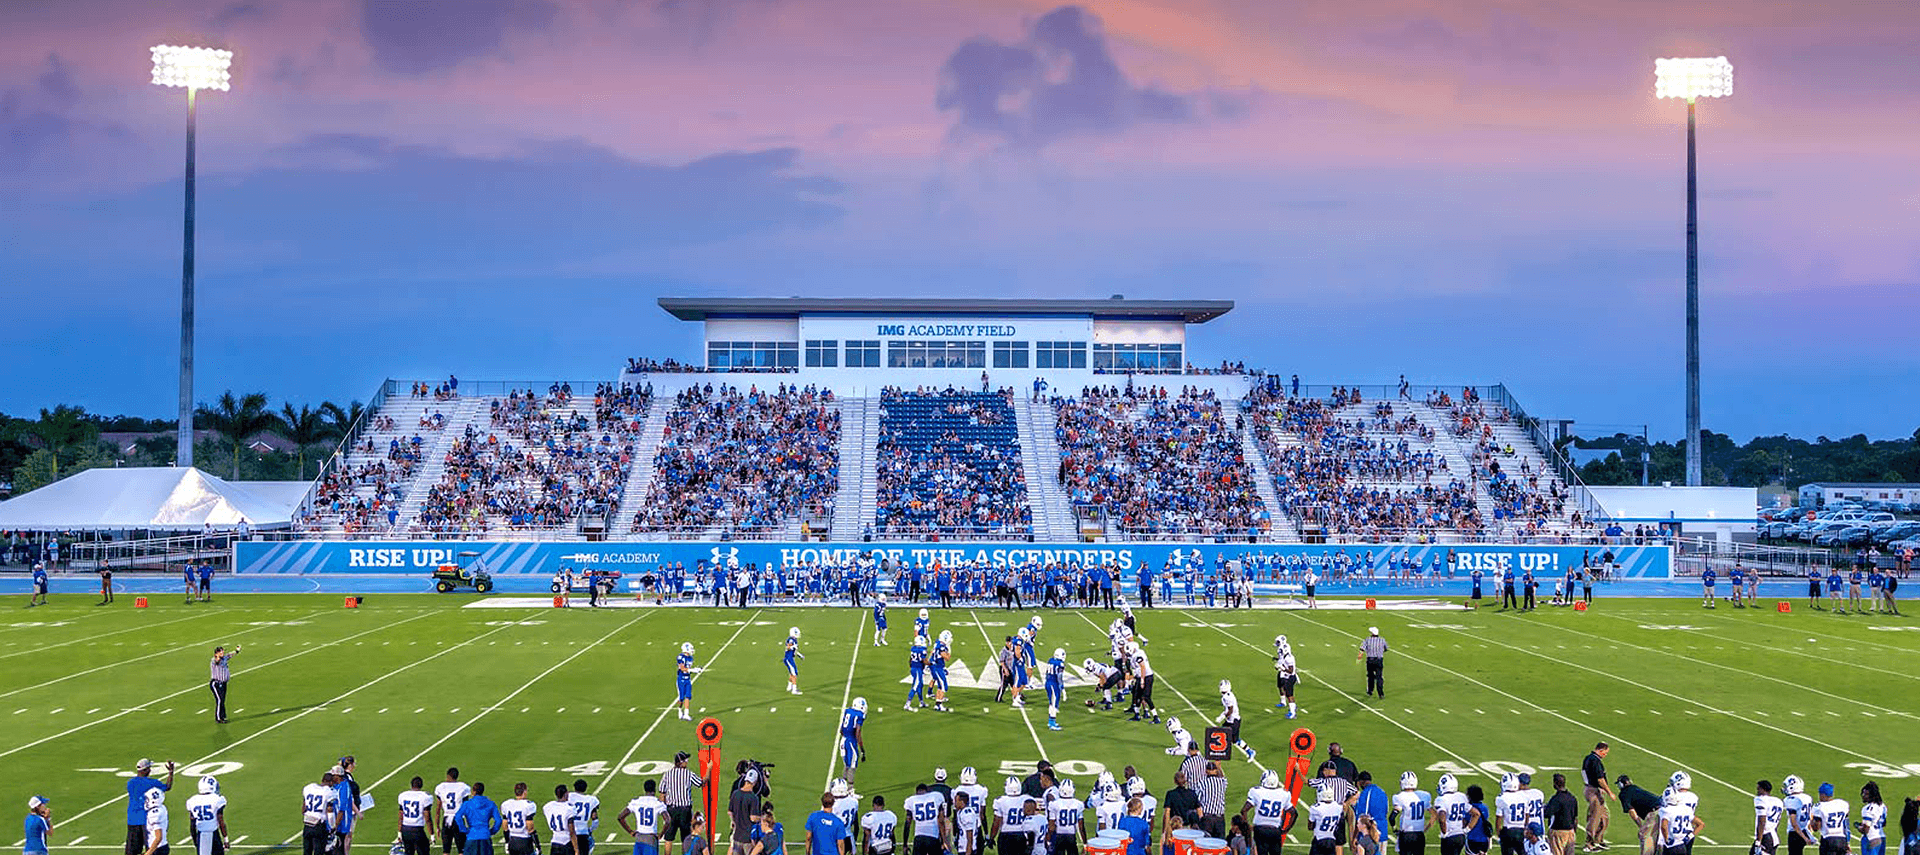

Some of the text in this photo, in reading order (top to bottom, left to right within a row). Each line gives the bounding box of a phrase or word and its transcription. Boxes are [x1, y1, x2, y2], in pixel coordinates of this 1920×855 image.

[877, 325, 1016, 336] IMG ACADEMY FIELD
[349, 548, 452, 567] RISE UP!
[602, 553, 661, 563] ACADEMY
[971, 549, 1133, 569] ASCENDERS
[1457, 552, 1559, 570] RISE UP!
[1209, 732, 1227, 751] 3
[561, 760, 675, 775] 40
[997, 759, 1106, 775] 50
[1425, 760, 1536, 776] 40
[305, 793, 323, 813] 32
[403, 800, 420, 818] 53
[446, 792, 456, 810] 3
[1258, 799, 1282, 818] 58
[574, 801, 590, 821] 21
[638, 807, 654, 826] 19
[914, 801, 936, 822] 56
[1059, 808, 1078, 827] 80
[1409, 801, 1425, 821] 10
[1509, 802, 1525, 821] 13
[1826, 811, 1845, 829] 57
[550, 813, 565, 832] 41
[875, 823, 893, 840] 48
